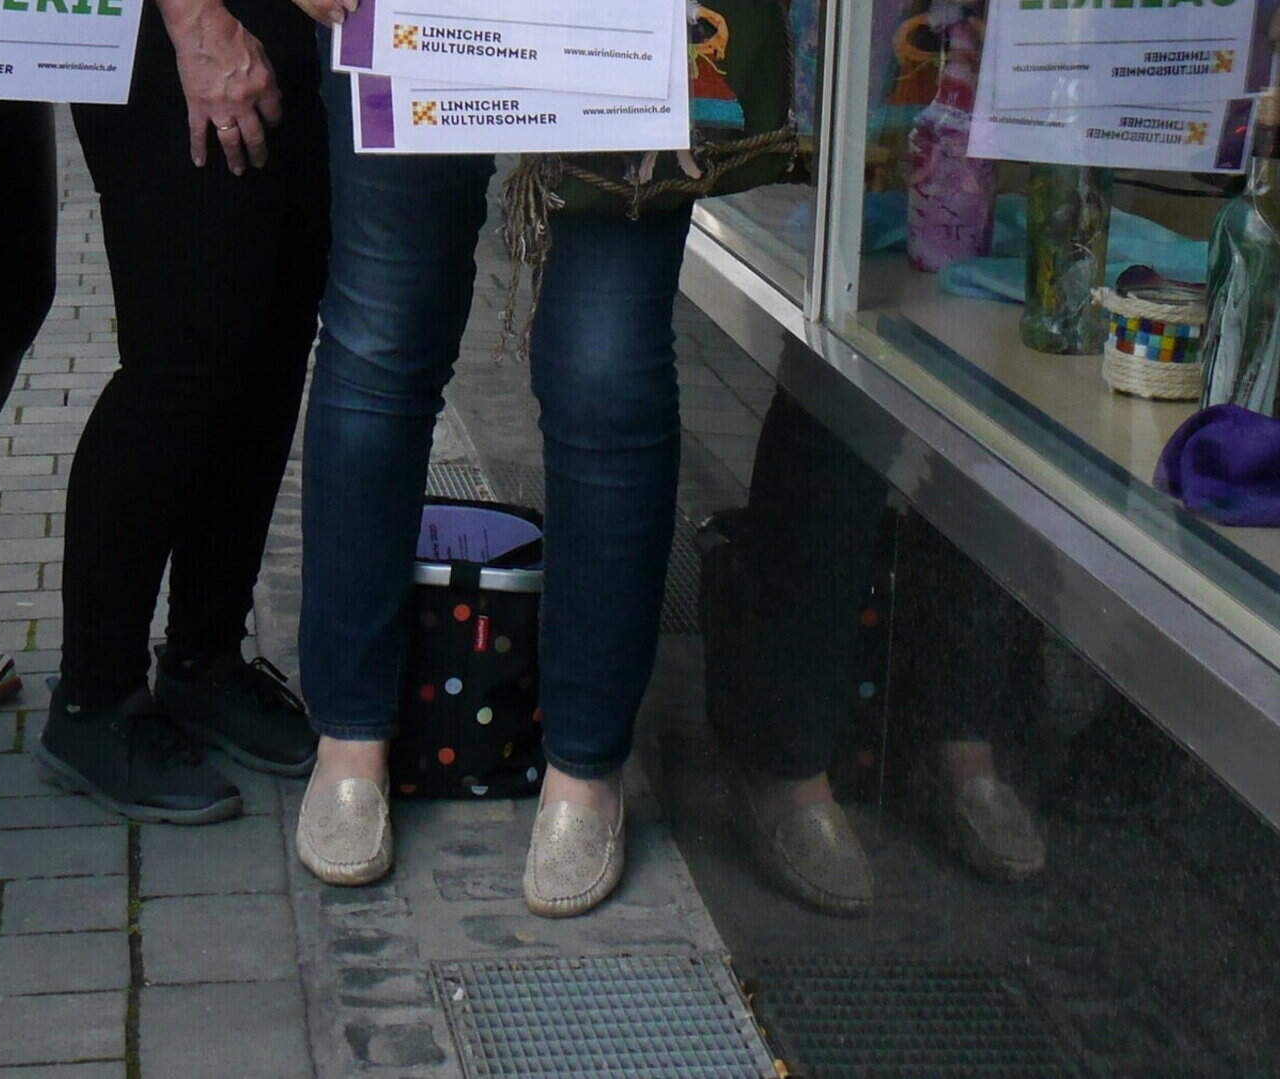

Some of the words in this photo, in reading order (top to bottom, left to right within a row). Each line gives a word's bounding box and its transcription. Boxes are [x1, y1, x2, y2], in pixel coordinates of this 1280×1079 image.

[423, 27, 502, 42] LINNICHER
[422, 42, 538, 60] KULTURSOMMER
[564, 48, 653, 61] www.wirinlinnich.de
[441, 101, 519, 112] LINNICHER
[583, 105, 671, 116] www.wirinlinnich.de
[442, 114, 557, 126] KULTURSOMMER
